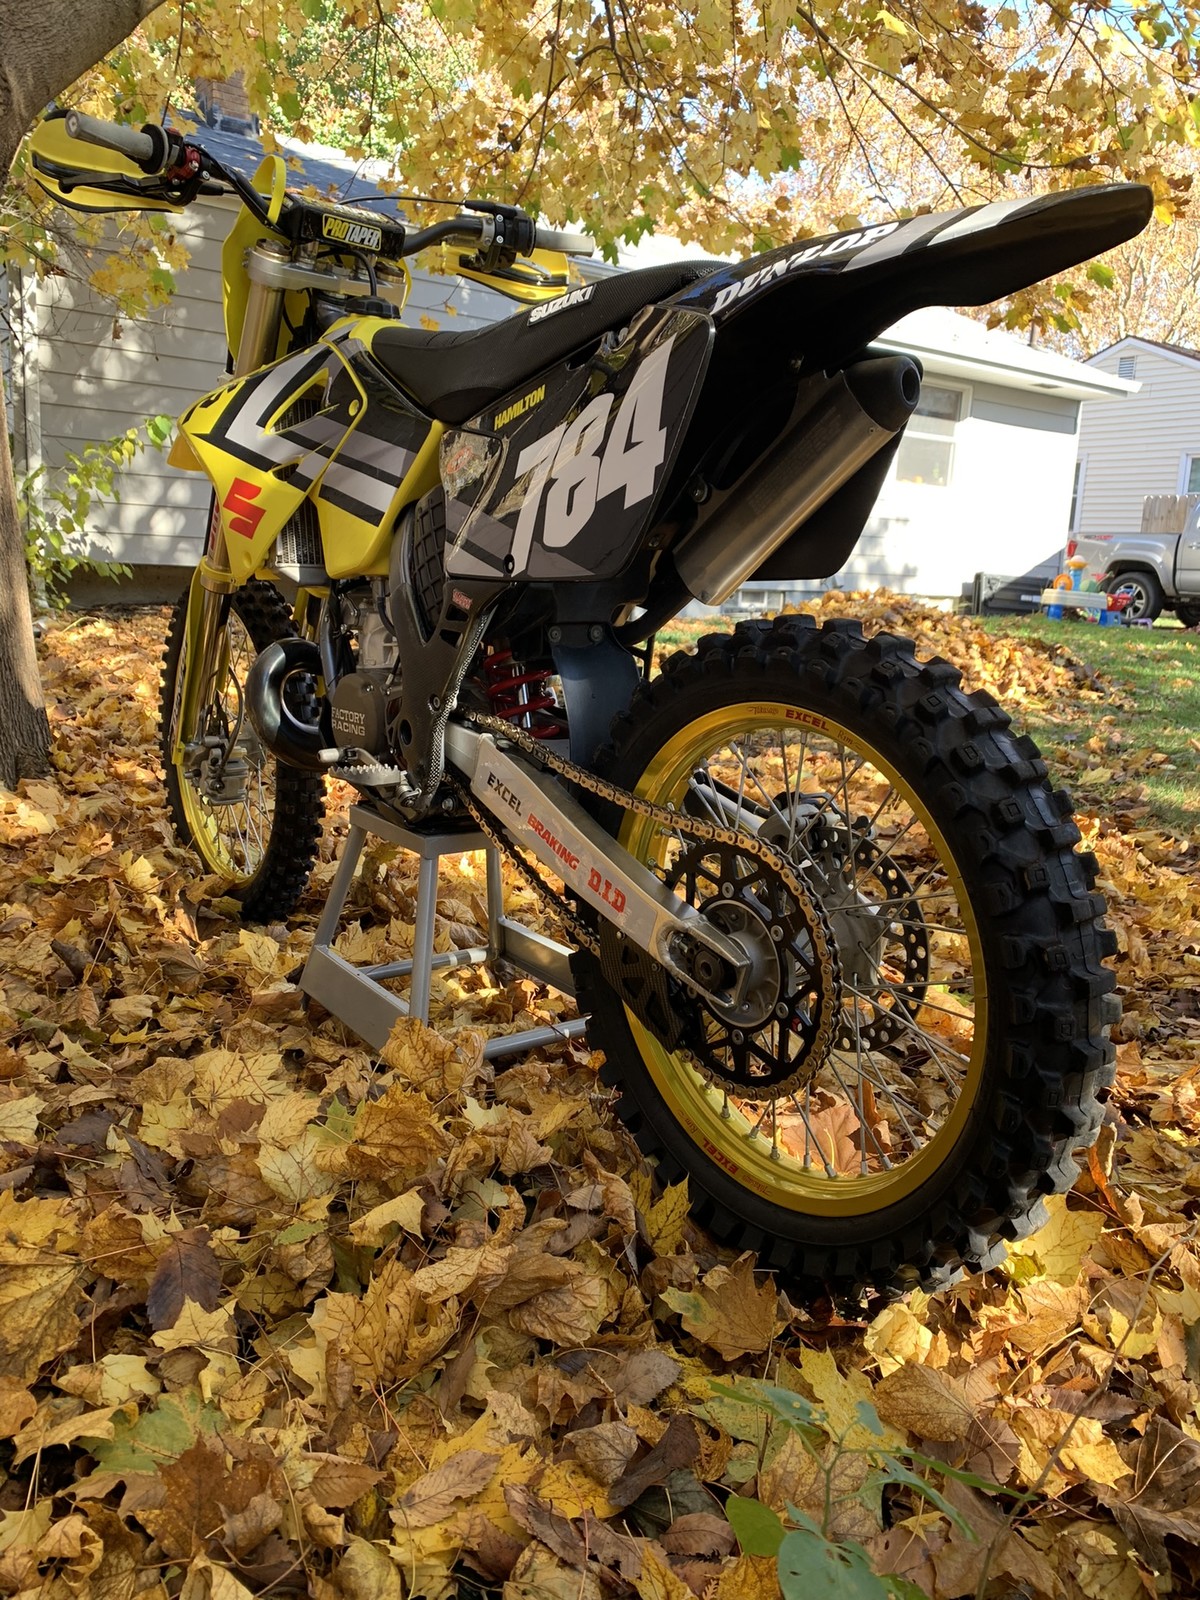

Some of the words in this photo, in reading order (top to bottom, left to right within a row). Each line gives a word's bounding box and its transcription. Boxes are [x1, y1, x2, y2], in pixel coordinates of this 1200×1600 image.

[324, 217, 381, 248] PROTAPER
[709, 221, 900, 315] DUNLOP
[529, 286, 594, 322] SUZUKI
[494, 384, 546, 431] HAMILTON
[510, 332, 678, 577] 784
[331, 706, 365, 725] FACTORY
[331, 719, 366, 736] RACING
[784, 708, 829, 731] EXCEL
[486, 771, 522, 816] EXCEL
[527, 813, 580, 870] BRAKING
[702, 1137, 739, 1175] EXCEL
